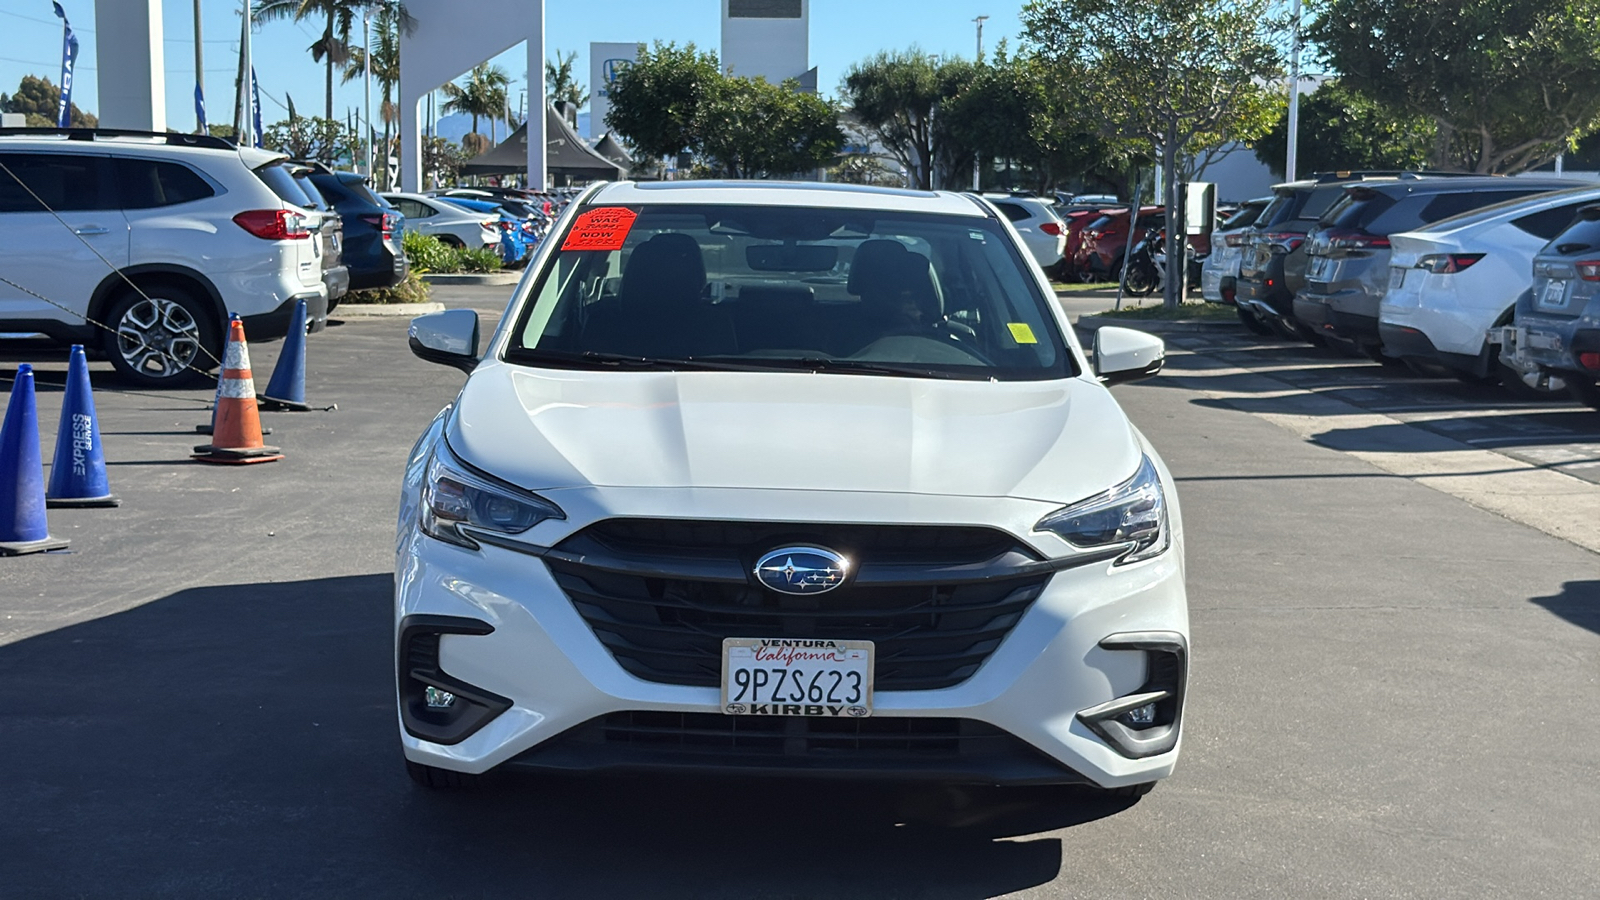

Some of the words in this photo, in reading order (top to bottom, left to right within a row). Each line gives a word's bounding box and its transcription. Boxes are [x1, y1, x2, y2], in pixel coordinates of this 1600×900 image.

[73, 413, 86, 476] EXPRESS
[84, 416, 92, 451] SERVICE
[756, 646, 845, 666] California
[761, 639, 836, 648] VENTURA
[734, 668, 861, 703] 9PZS623
[751, 704, 844, 716] KIRBY
